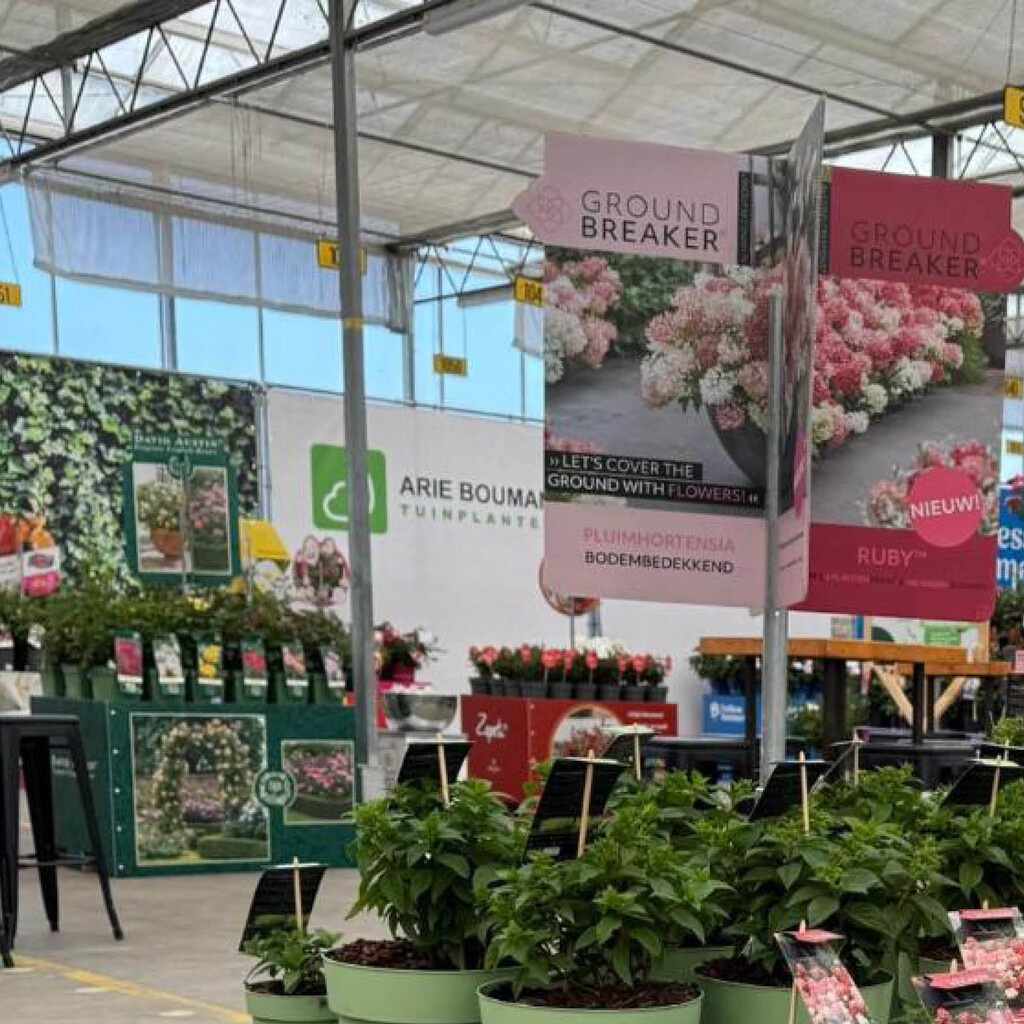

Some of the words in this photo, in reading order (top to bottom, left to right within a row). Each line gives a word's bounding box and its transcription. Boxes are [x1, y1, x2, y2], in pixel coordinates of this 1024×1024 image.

[581, 190, 720, 226] GROUND
[581, 215, 719, 251] BREAKER
[851, 220, 981, 256] GROUND
[850, 246, 980, 281] BREAKER
[606, 458, 660, 476] COVER
[665, 462, 695, 478] THE
[400, 475, 454, 499] ARIE
[548, 473, 619, 492] GROUND
[623, 478, 665, 497] WITH
[668, 483, 746, 504] FLOWERS!
[911, 494, 981, 519] NIEUW!
[583, 528, 736, 553] PLUIMHORTENSIA
[585, 551, 734, 574] BODEMBEDEKKEND
